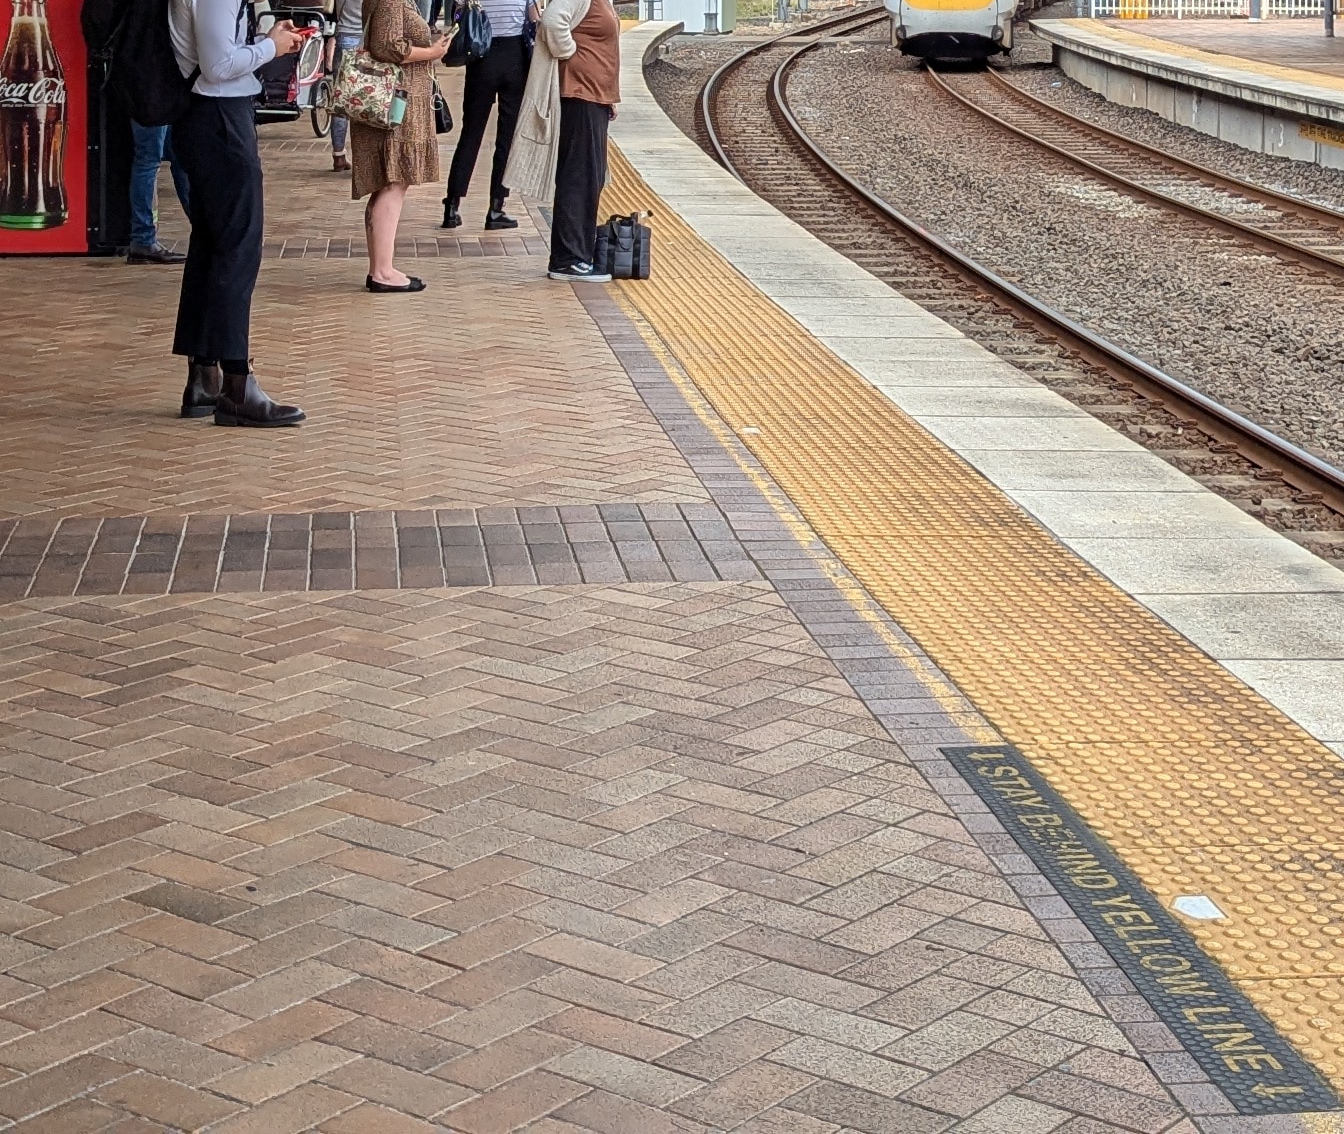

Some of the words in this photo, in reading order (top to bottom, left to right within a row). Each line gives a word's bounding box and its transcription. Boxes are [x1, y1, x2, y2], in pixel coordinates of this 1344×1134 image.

[977, 765, 1049, 810] STAY
[1019, 813, 1119, 891] BEHIND
[1091, 894, 1219, 996] YELLOW
[1184, 1006, 1284, 1073] LINE
